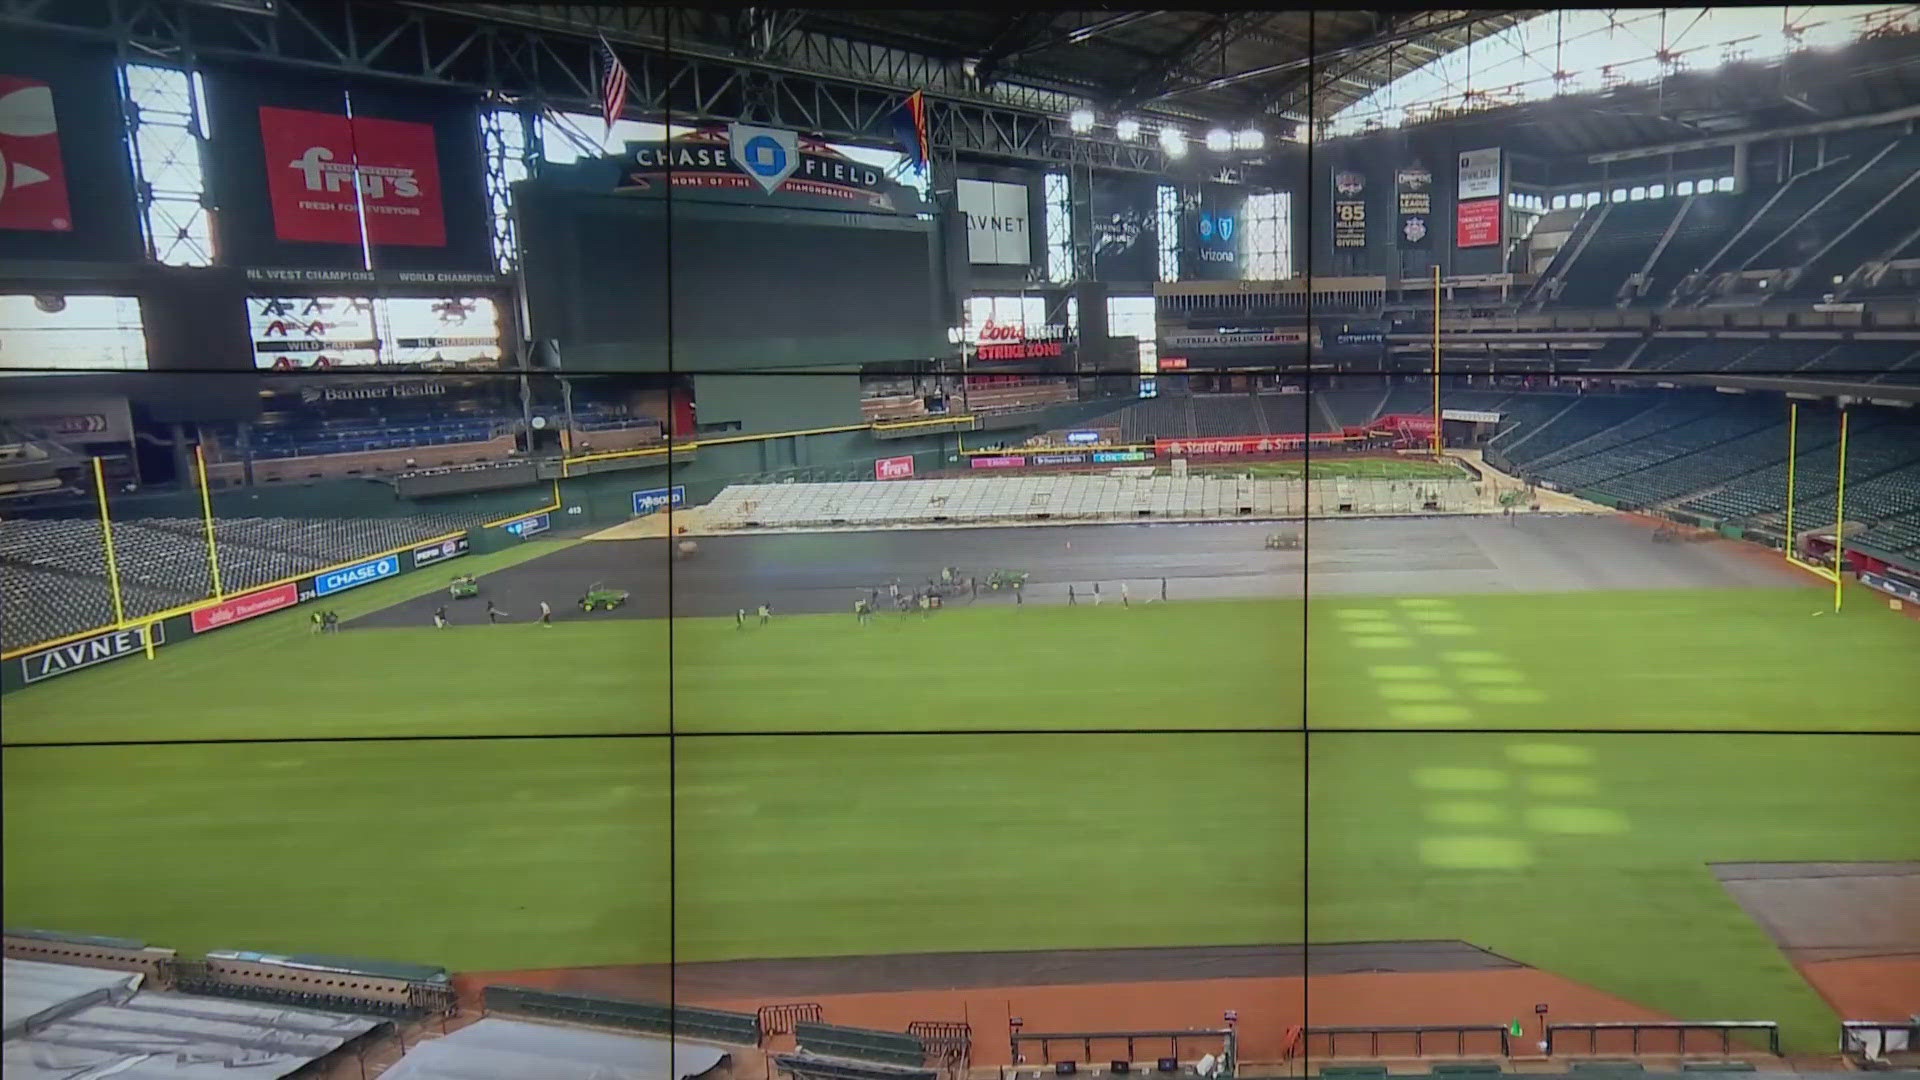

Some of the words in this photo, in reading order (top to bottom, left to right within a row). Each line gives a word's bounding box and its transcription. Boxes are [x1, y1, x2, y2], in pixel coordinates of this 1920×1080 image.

[636, 149, 727, 167] CHASE
[288, 146, 420, 198] fry's
[806, 159, 878, 185] FIELD
[671, 178, 702, 186] HOME
[710, 178, 723, 186] OF
[731, 179, 750, 187] THE
[786, 182, 854, 199] DIAMONDBACKS
[299, 200, 335, 211] FRESH
[366, 205, 420, 216] EVERYONE
[1400, 200, 1430, 208] LEAGUE
[1336, 239, 1366, 247] GIVING
[1199, 247, 1234, 263] Arizona
[246, 270, 262, 279] NL
[266, 271, 302, 280] WEST
[306, 271, 375, 282] CHAMPIONS
[399, 273, 435, 282] WORLD
[438, 273, 496, 283] CHAMPIONS
[979, 314, 1025, 341] Coors
[1025, 324, 1066, 341] LIGHT
[287, 341, 319, 351] WILD
[418, 338, 432, 347] NL
[978, 344, 1025, 360] STRIKE
[1027, 342, 1062, 357] ZONE
[325, 388, 388, 401] Banner
[392, 382, 446, 397] Health
[327, 566, 377, 589] CHASE
[300, 589, 316, 602] 374
[41, 628, 149, 675] AVNET
